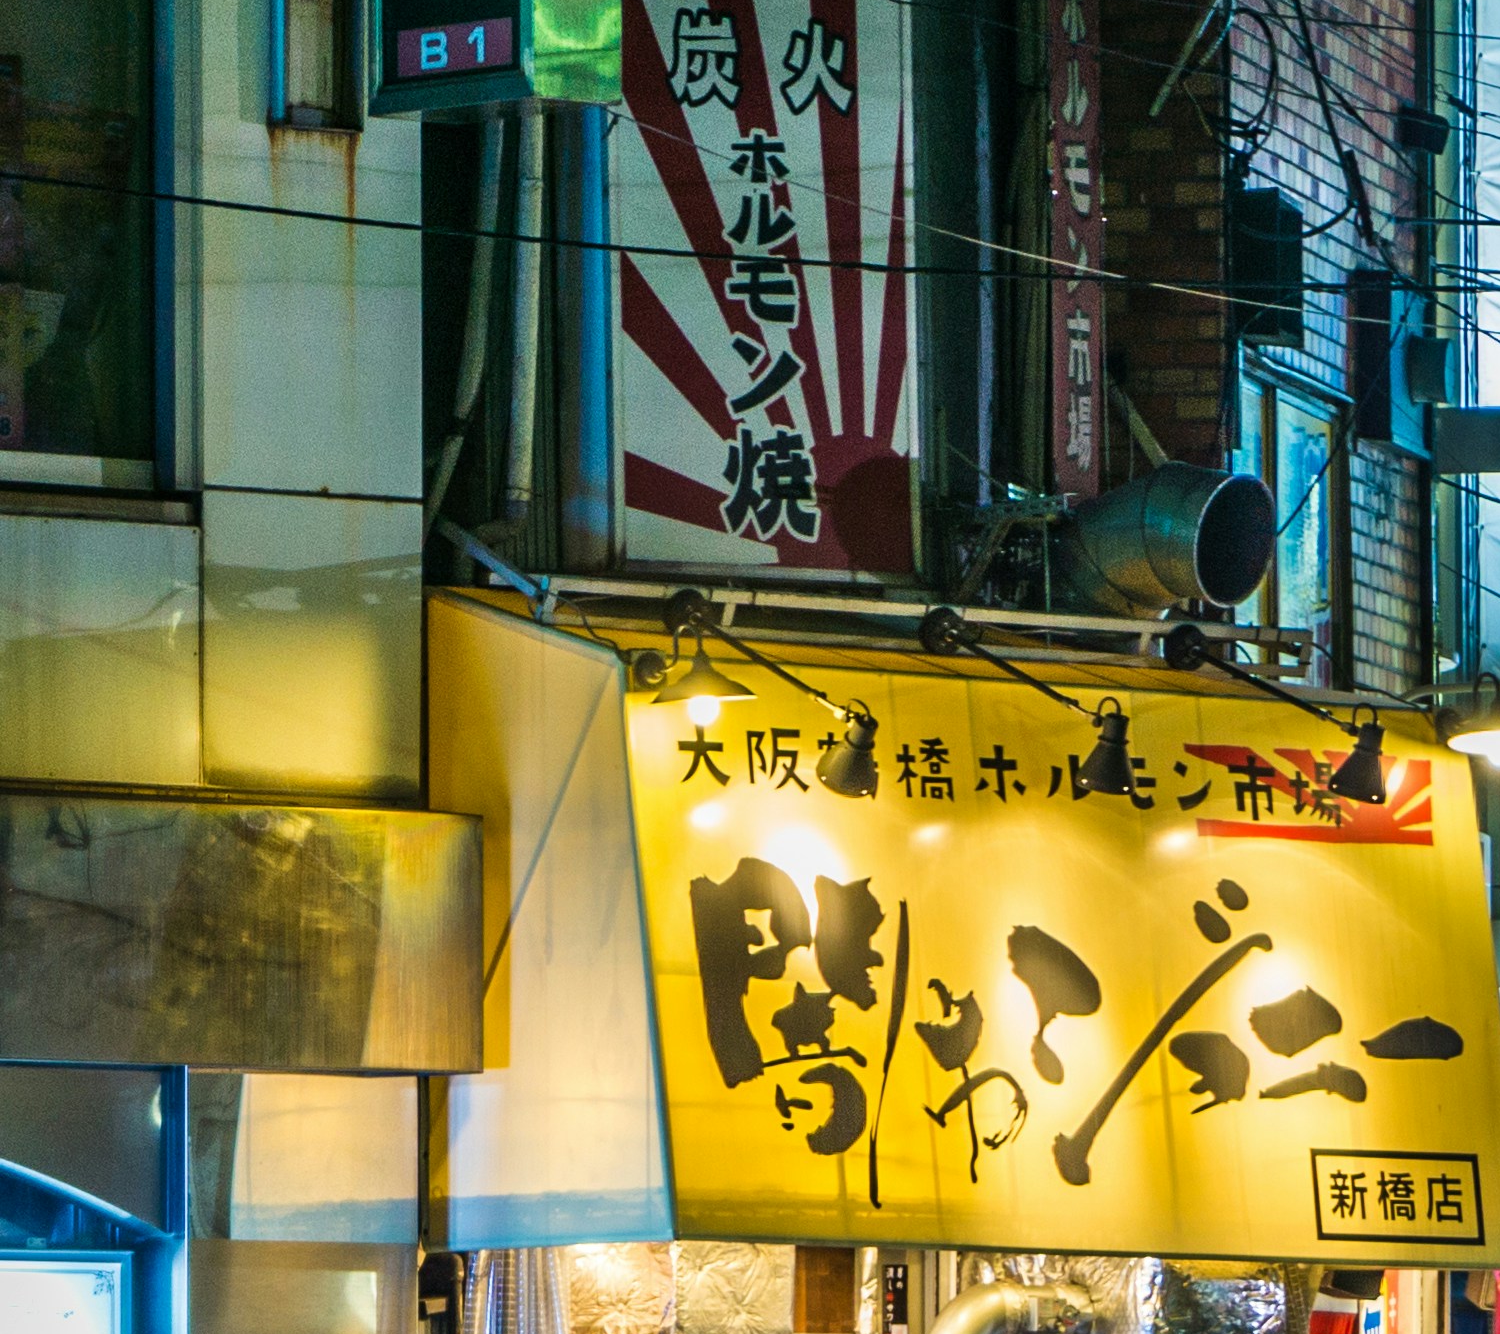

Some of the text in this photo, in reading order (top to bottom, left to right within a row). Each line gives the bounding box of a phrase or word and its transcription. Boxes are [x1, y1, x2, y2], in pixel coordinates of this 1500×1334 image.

[719, 129, 823, 543] ホルモン焼
[1328, 1165, 1467, 1227] 新橋店
